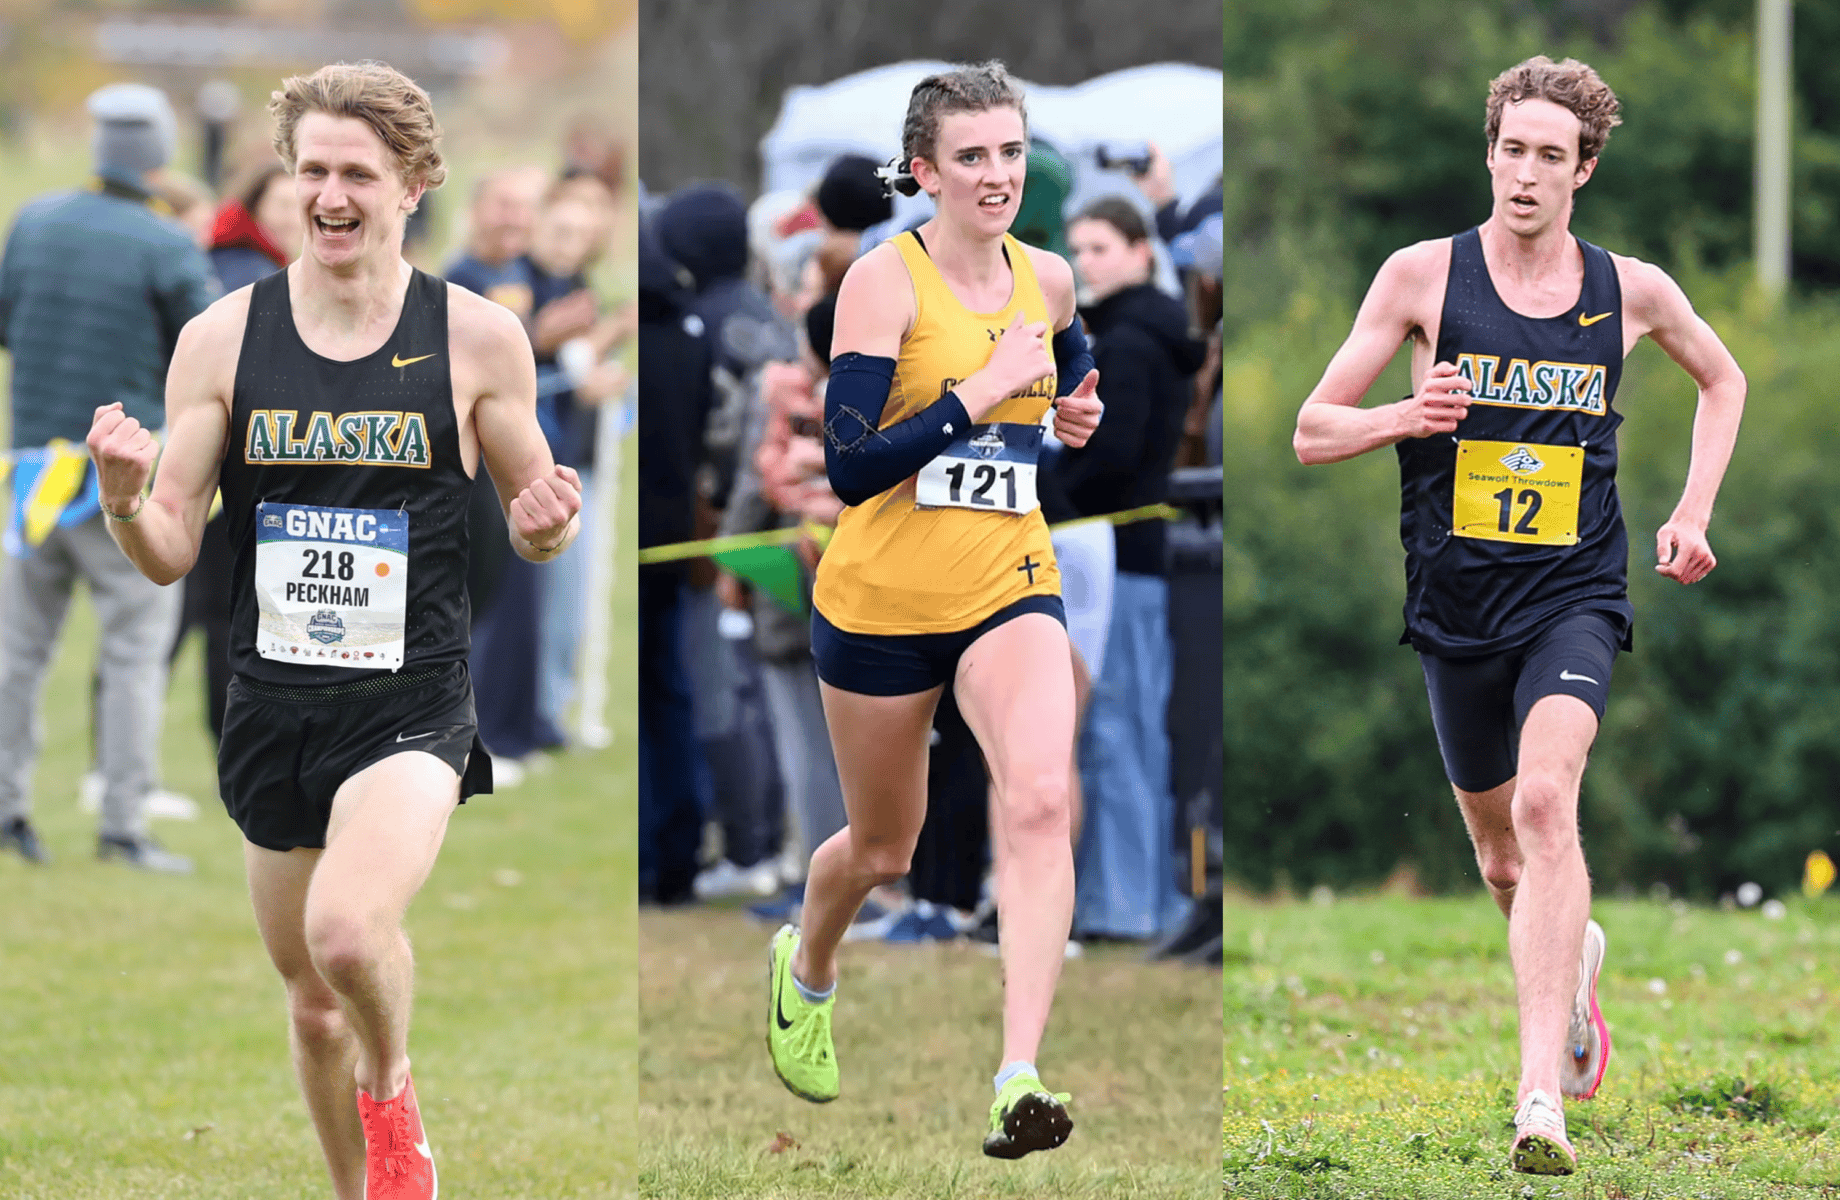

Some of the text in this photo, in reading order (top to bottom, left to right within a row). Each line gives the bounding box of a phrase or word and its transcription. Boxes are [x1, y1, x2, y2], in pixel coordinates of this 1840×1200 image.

[1450, 353, 1607, 416] ALASKA
[245, 410, 431, 468] ALASKA
[945, 462, 1017, 509] 121
[1468, 472, 1571, 488] Seawolf Throwdown
[263, 518, 283, 528] GNAC
[285, 509, 377, 541] GNAC
[1493, 487, 1543, 535] 12
[301, 548, 355, 581] 218
[286, 581, 370, 607] PECKHAM
[316, 612, 337, 622] GNAC
